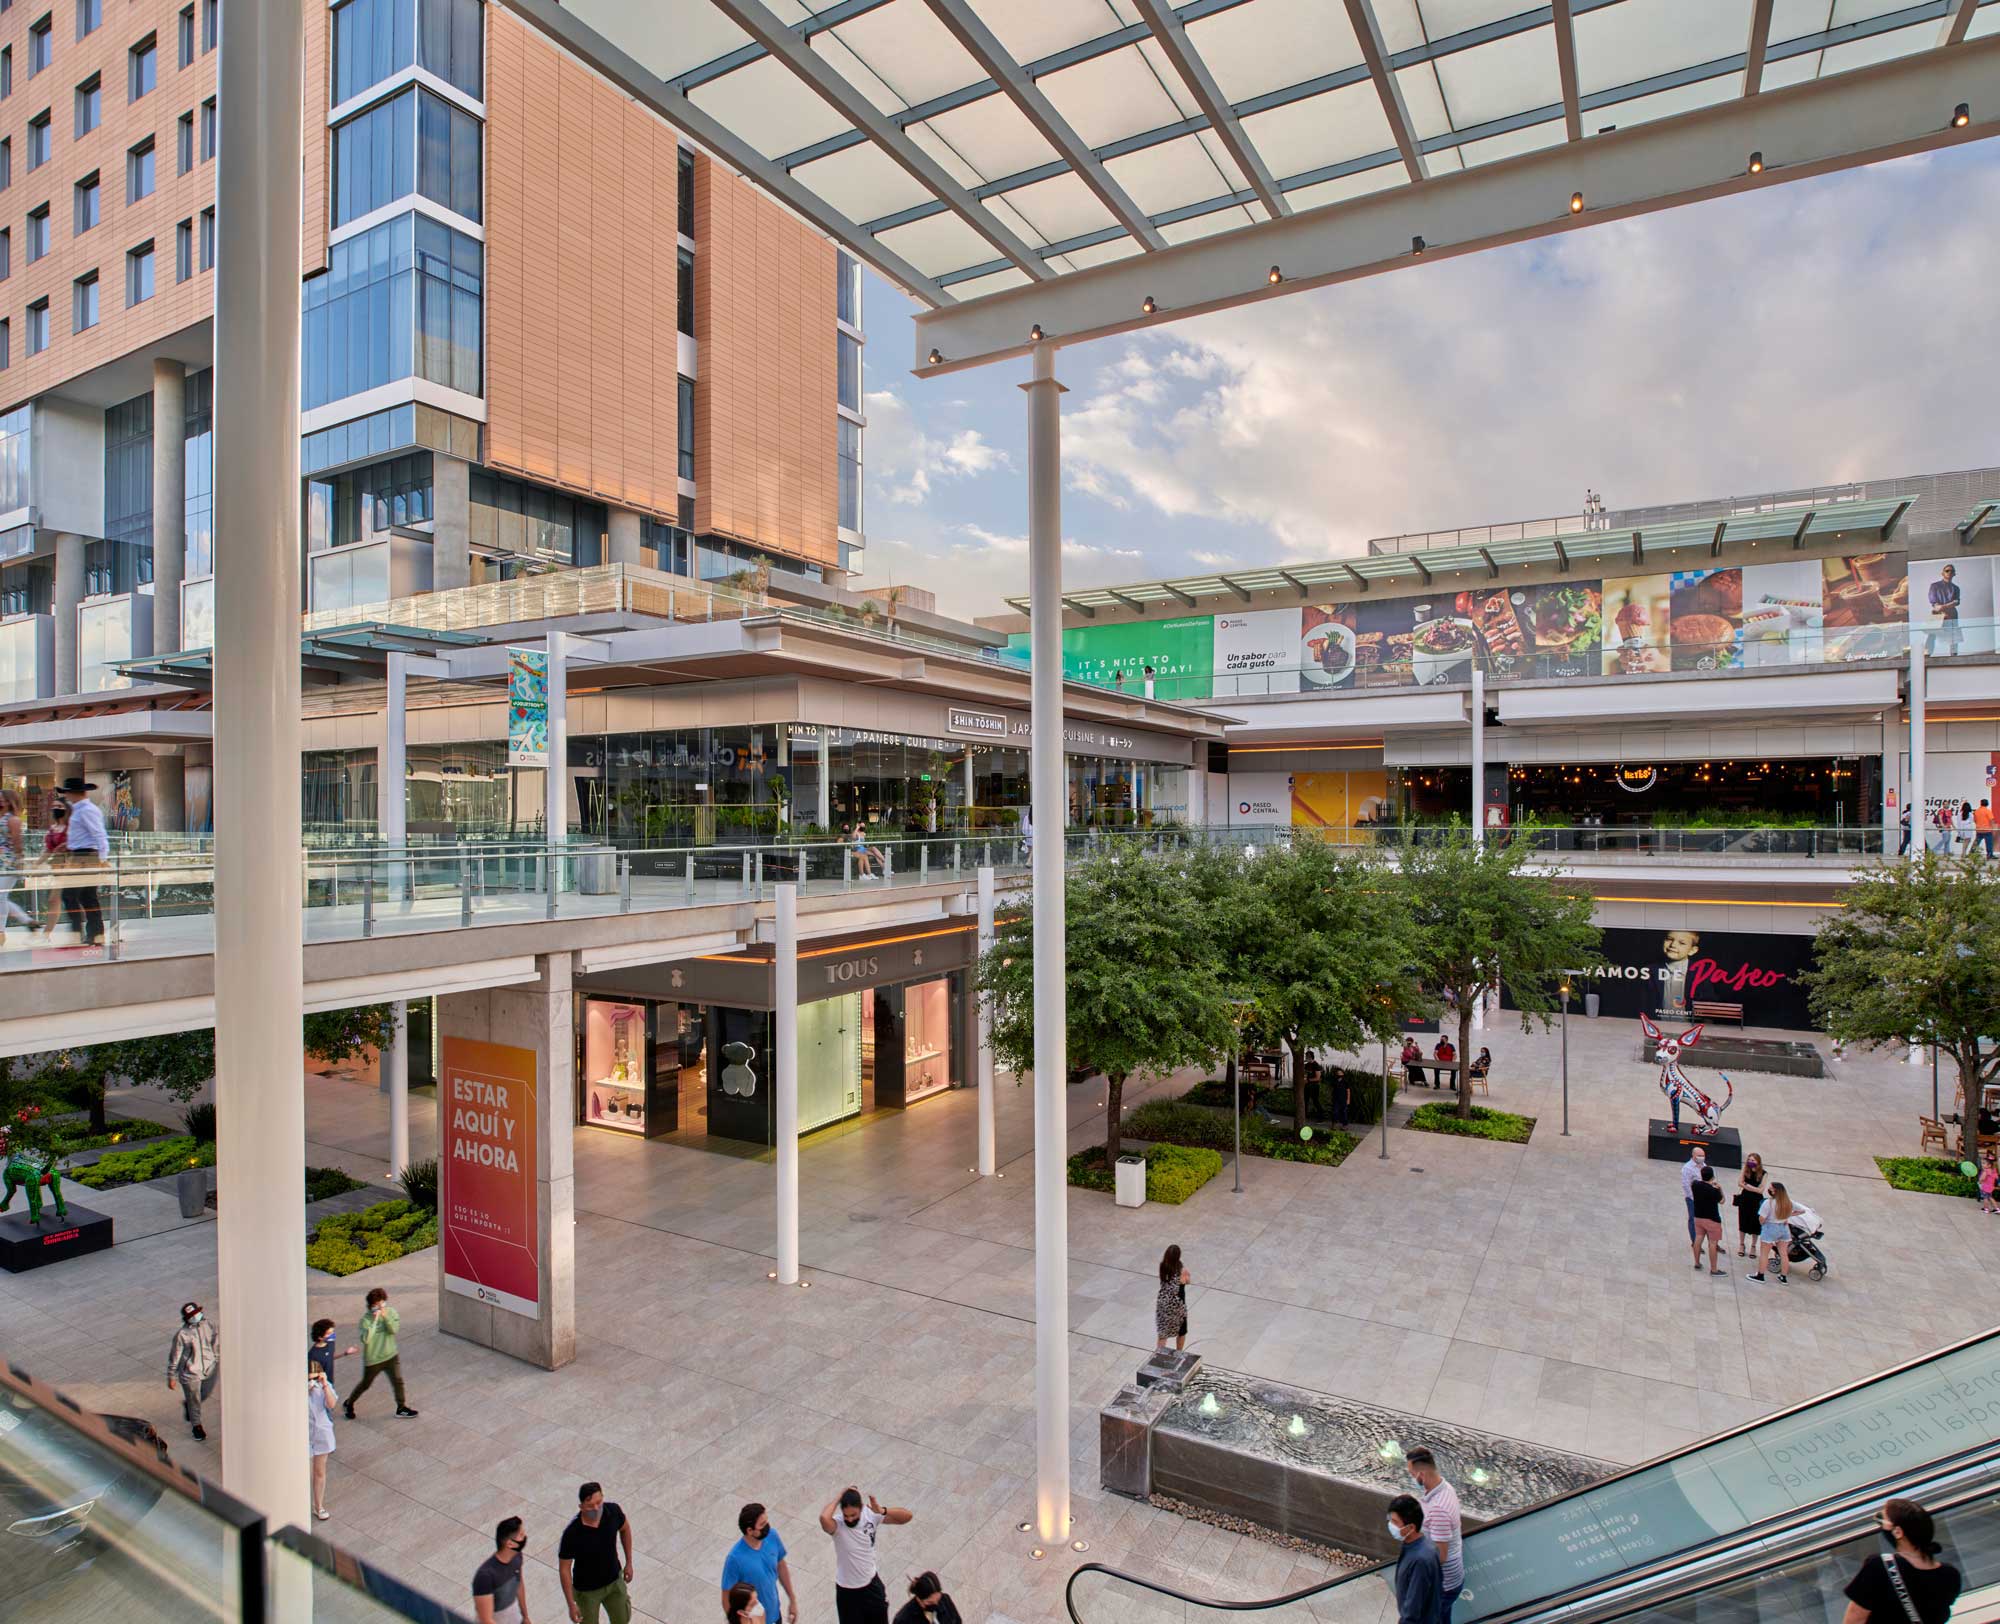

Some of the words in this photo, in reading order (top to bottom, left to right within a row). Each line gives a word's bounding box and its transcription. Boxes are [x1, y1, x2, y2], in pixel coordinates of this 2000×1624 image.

[1113, 656, 1145, 668] NICE
[1152, 655, 1169, 664] TO
[1227, 654, 1241, 662] Un
[1242, 652, 1267, 661] sabor
[1268, 651, 1287, 660] para
[1226, 660, 1248, 669] cada
[1249, 659, 1275, 670] gusto
[1078, 669, 1100, 680] SEE
[1107, 668, 1132, 679] YU
[954, 715, 973, 727] SHIN
[788, 724, 804, 735] HIN
[1063, 729, 1094, 743] CUISINE
[824, 957, 878, 984] TOUS
[1658, 967, 1684, 981] DE
[1688, 958, 1786, 998] Paseo
[453, 1078, 509, 1109] ESTAR
[453, 1107, 500, 1138] AQUÍ
[503, 1119, 516, 1141] Y
[453, 1138, 519, 1173] AHORA
[454, 1213, 467, 1222] QUE
